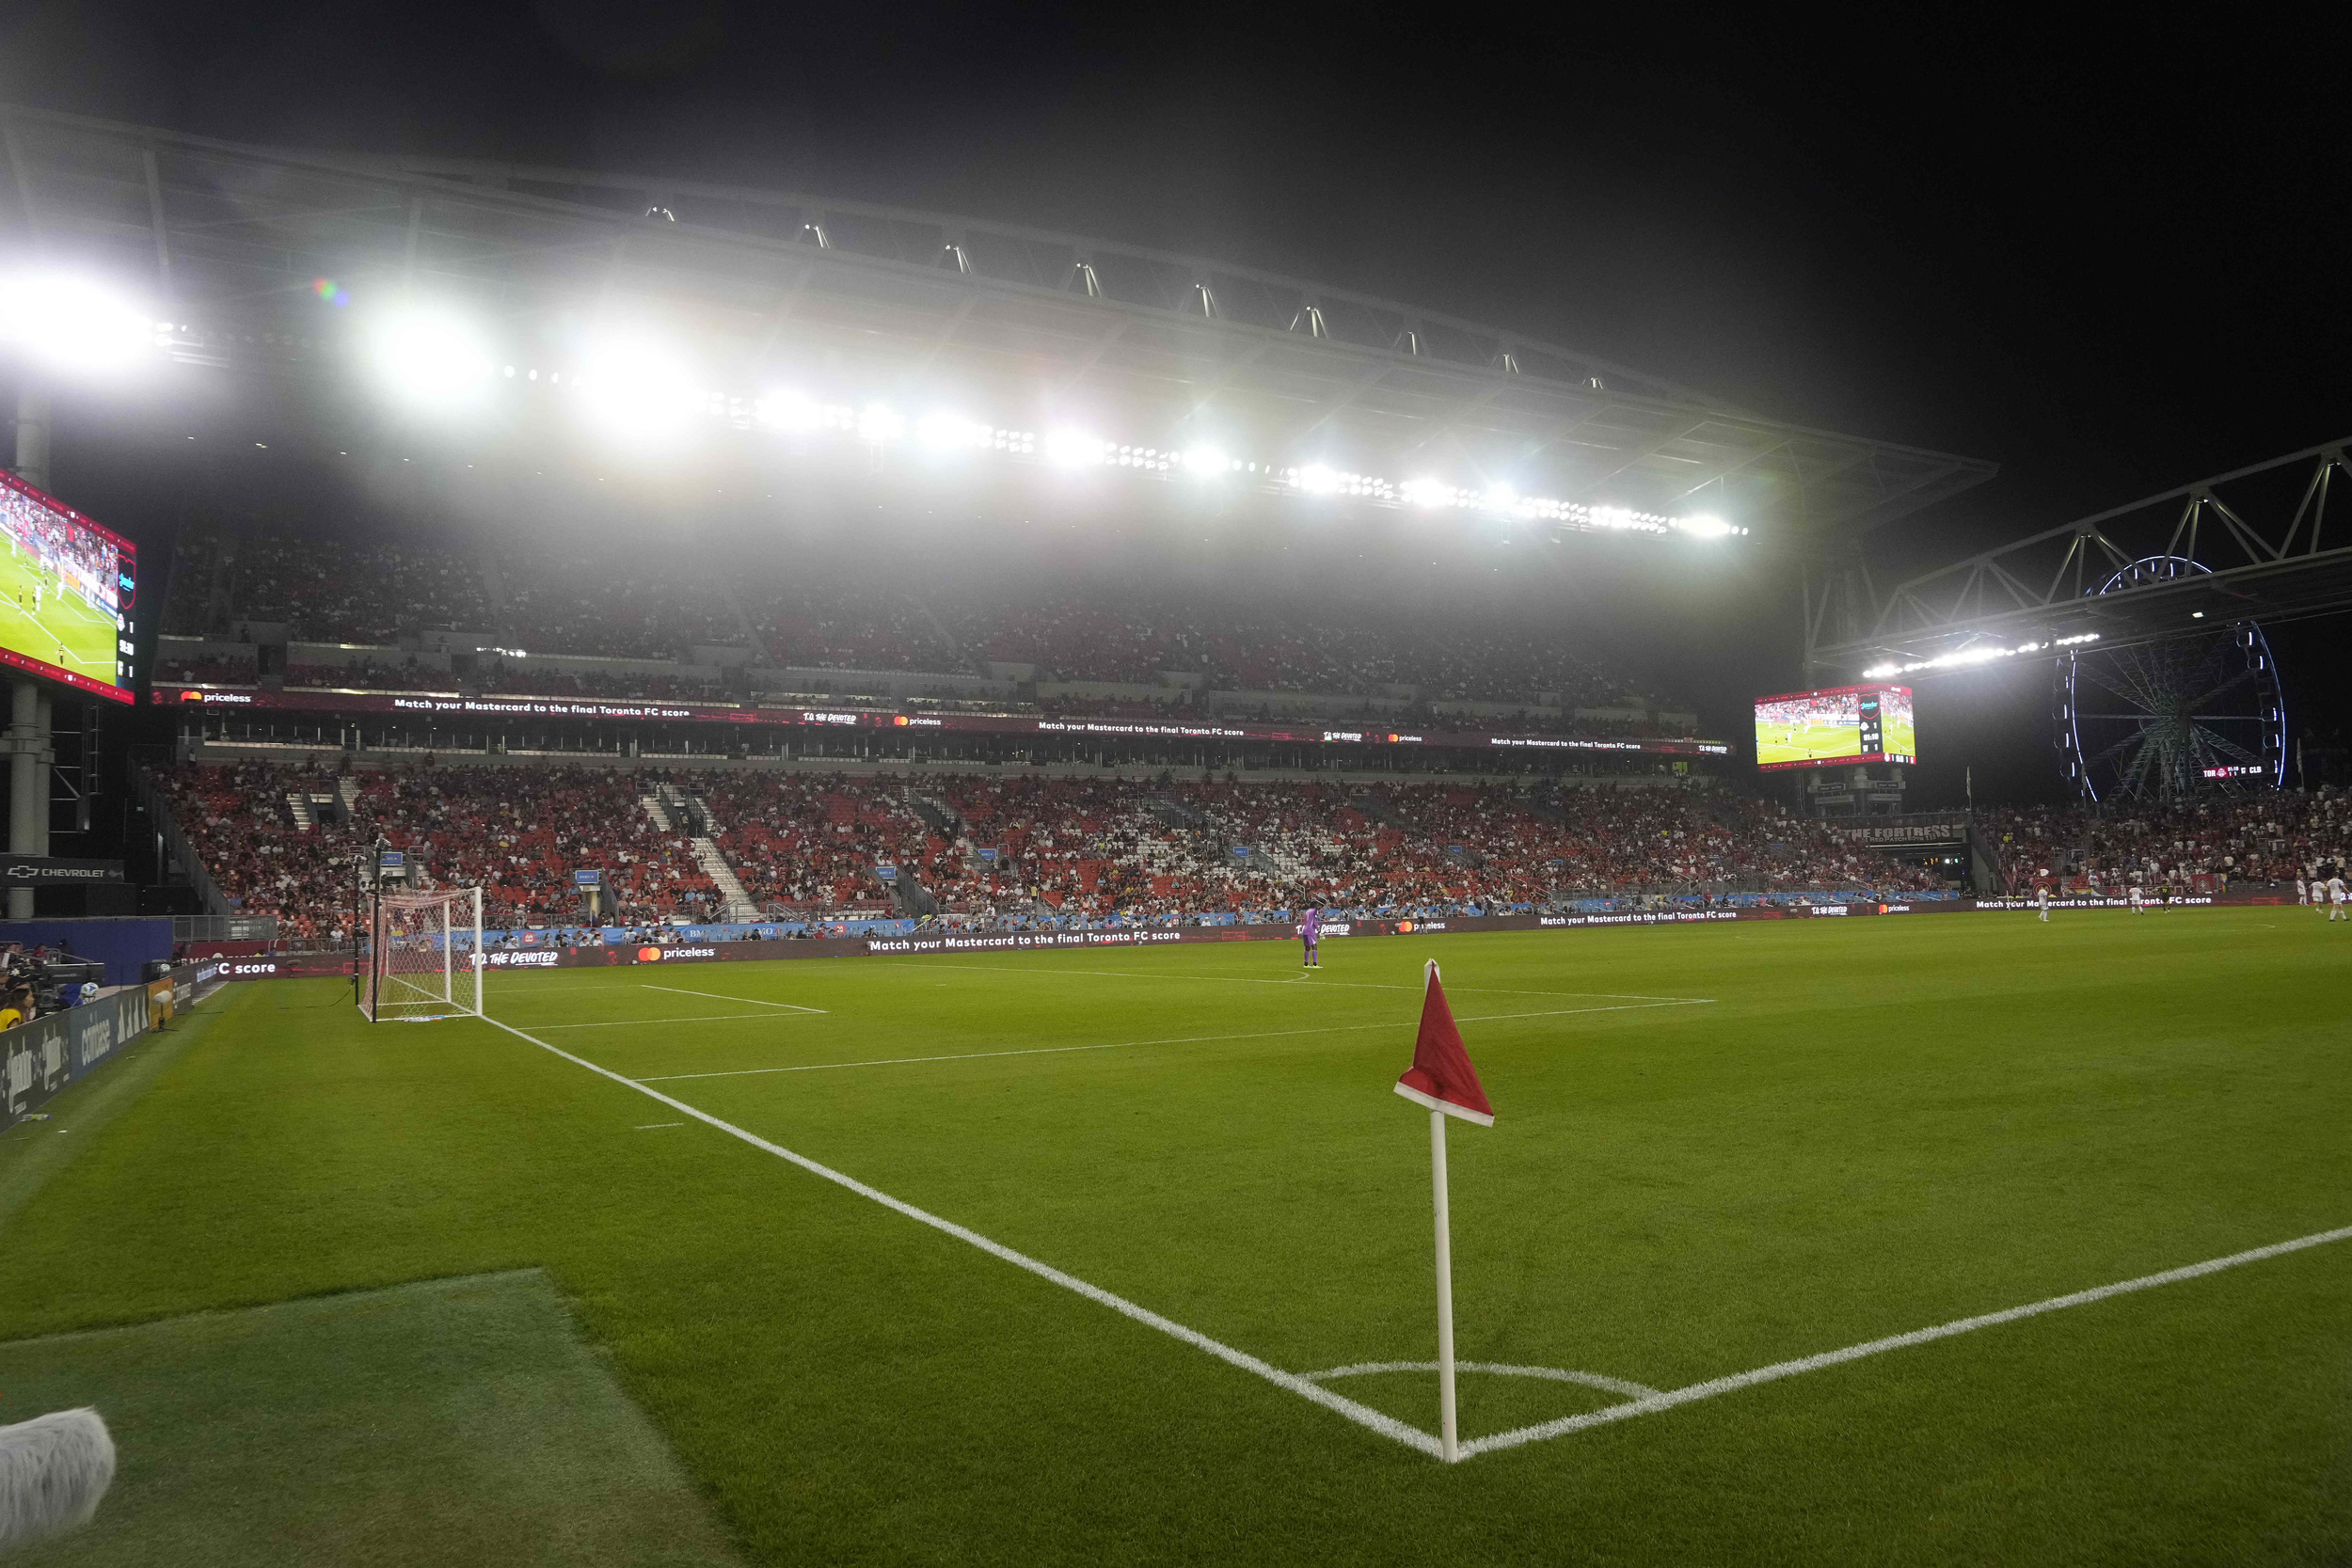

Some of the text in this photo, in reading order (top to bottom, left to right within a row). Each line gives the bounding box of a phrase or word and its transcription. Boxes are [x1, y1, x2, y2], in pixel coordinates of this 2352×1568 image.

[204, 692, 250, 704] priceless
[394, 699, 432, 708] Match
[436, 702, 462, 711] your
[465, 702, 531, 712] Mastercard
[533, 704, 547, 712] to
[549, 704, 568, 713] the
[571, 705, 596, 714] final
[599, 706, 642, 716] Toronto
[803, 712, 857, 725] T.O. THE DEVOTED
[909, 718, 942, 726] priceless
[1039, 721, 1065, 730] Match
[1067, 723, 1086, 732] your
[1087, 723, 1133, 732] Mastercard
[1181, 726, 1210, 735] Toronto
[2202, 766, 2263, 778] TOR CLB
[1874, 824, 1950, 838] FORTRESS
[41, 868, 104, 878] CHEVROLET
[1976, 900, 2004, 909] Match
[2026, 898, 2074, 907] Maercard
[2089, 897, 2105, 906] the
[2106, 897, 2127, 906] final
[1540, 917, 1565, 926] Match
[1567, 916, 1585, 926] your
[1587, 914, 1631, 924] Mastercard
[1658, 912, 1675, 921] final
[1677, 911, 1705, 920] Toronto
[1707, 911, 1716, 919] FC
[1320, 924, 1350, 935] DEVOTED
[869, 931, 1181, 951] Match your Mastercard to the final Toronto FC score
[663, 947, 715, 958] priceless
[489, 952, 509, 965] THE
[510, 952, 558, 966] DEVOTED
[234, 964, 276, 974] score
